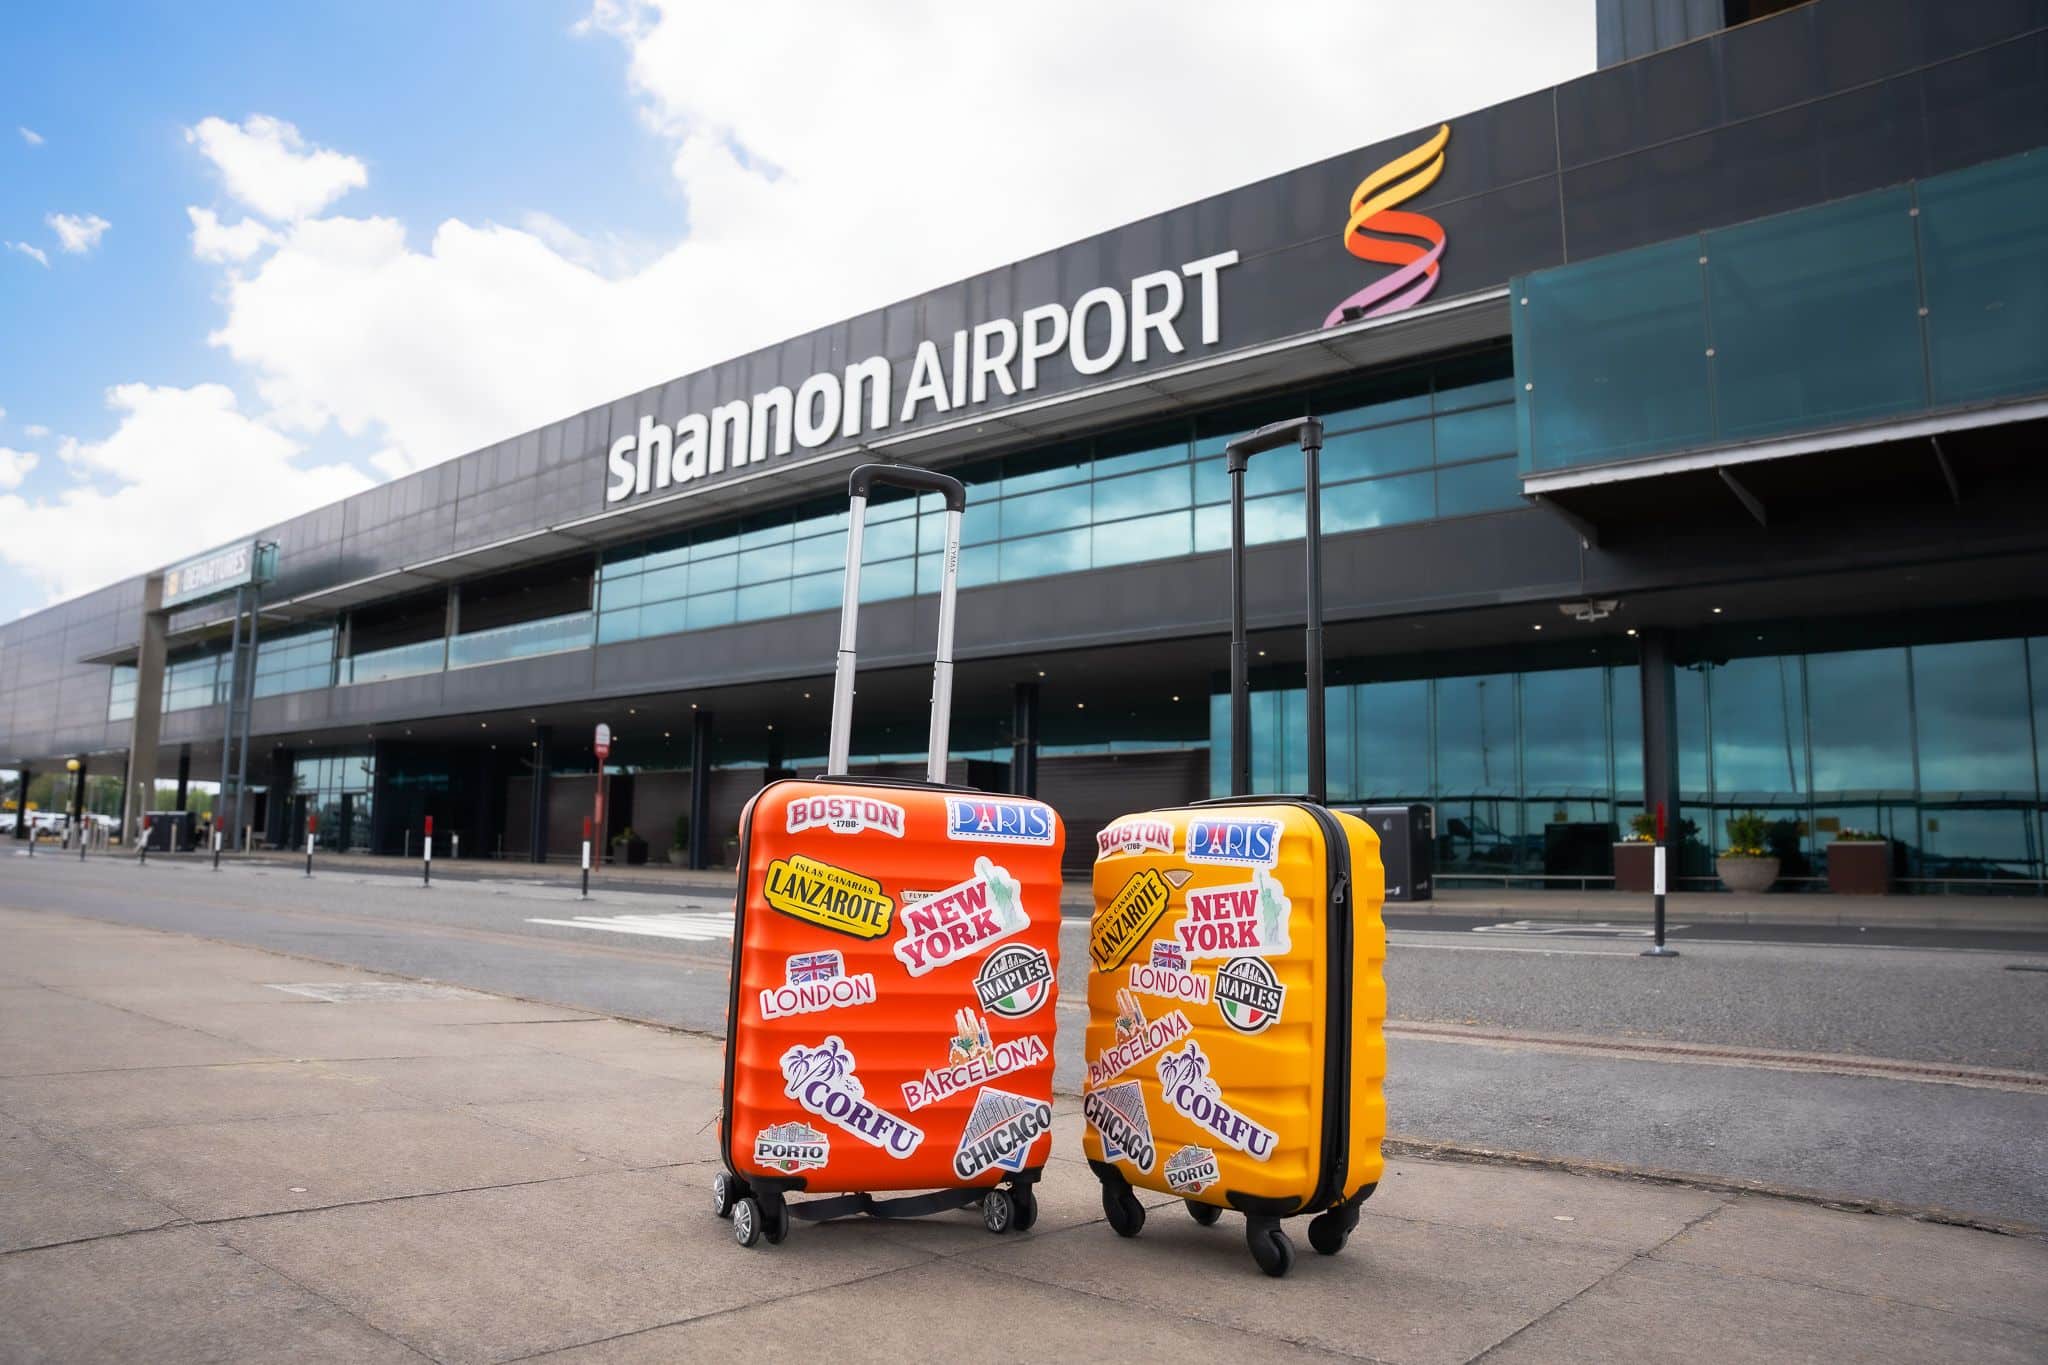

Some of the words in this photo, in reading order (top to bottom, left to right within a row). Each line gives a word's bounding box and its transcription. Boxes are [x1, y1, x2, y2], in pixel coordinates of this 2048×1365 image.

[606, 354, 892, 503] shannon
[900, 250, 1240, 422] AIRPORT
[791, 799, 899, 832] BOSTON
[954, 802, 1046, 835] PARIS
[1100, 824, 1170, 852] BOSTON
[1192, 823, 1270, 858] PARIS
[770, 868, 886, 928] LANZAROTE
[795, 862, 823, 878] ISLAS
[827, 873, 873, 895] CANARIAS
[908, 881, 987, 937] NEW
[1094, 878, 1162, 964] LANZAROTE
[1190, 889, 1258, 922] NEW
[901, 909, 1001, 969] YORK
[1179, 920, 1260, 952] YORK
[764, 977, 871, 1014] LONDON
[981, 959, 1047, 1001] NAPLES
[1131, 966, 1207, 1000] LONDON
[1218, 976, 1279, 1010] NAPLES
[1091, 1014, 1188, 1085] BARCELONA
[904, 1038, 1044, 1108] BARCELONA
[804, 1080, 919, 1152] CORFU
[1084, 1093, 1154, 1171] CHICAGO
[1176, 1084, 1272, 1155] CORFU
[759, 1143, 823, 1158] PORTO
[955, 1104, 1051, 1178] CHICAGO
[1168, 1162, 1214, 1186] PORTO
